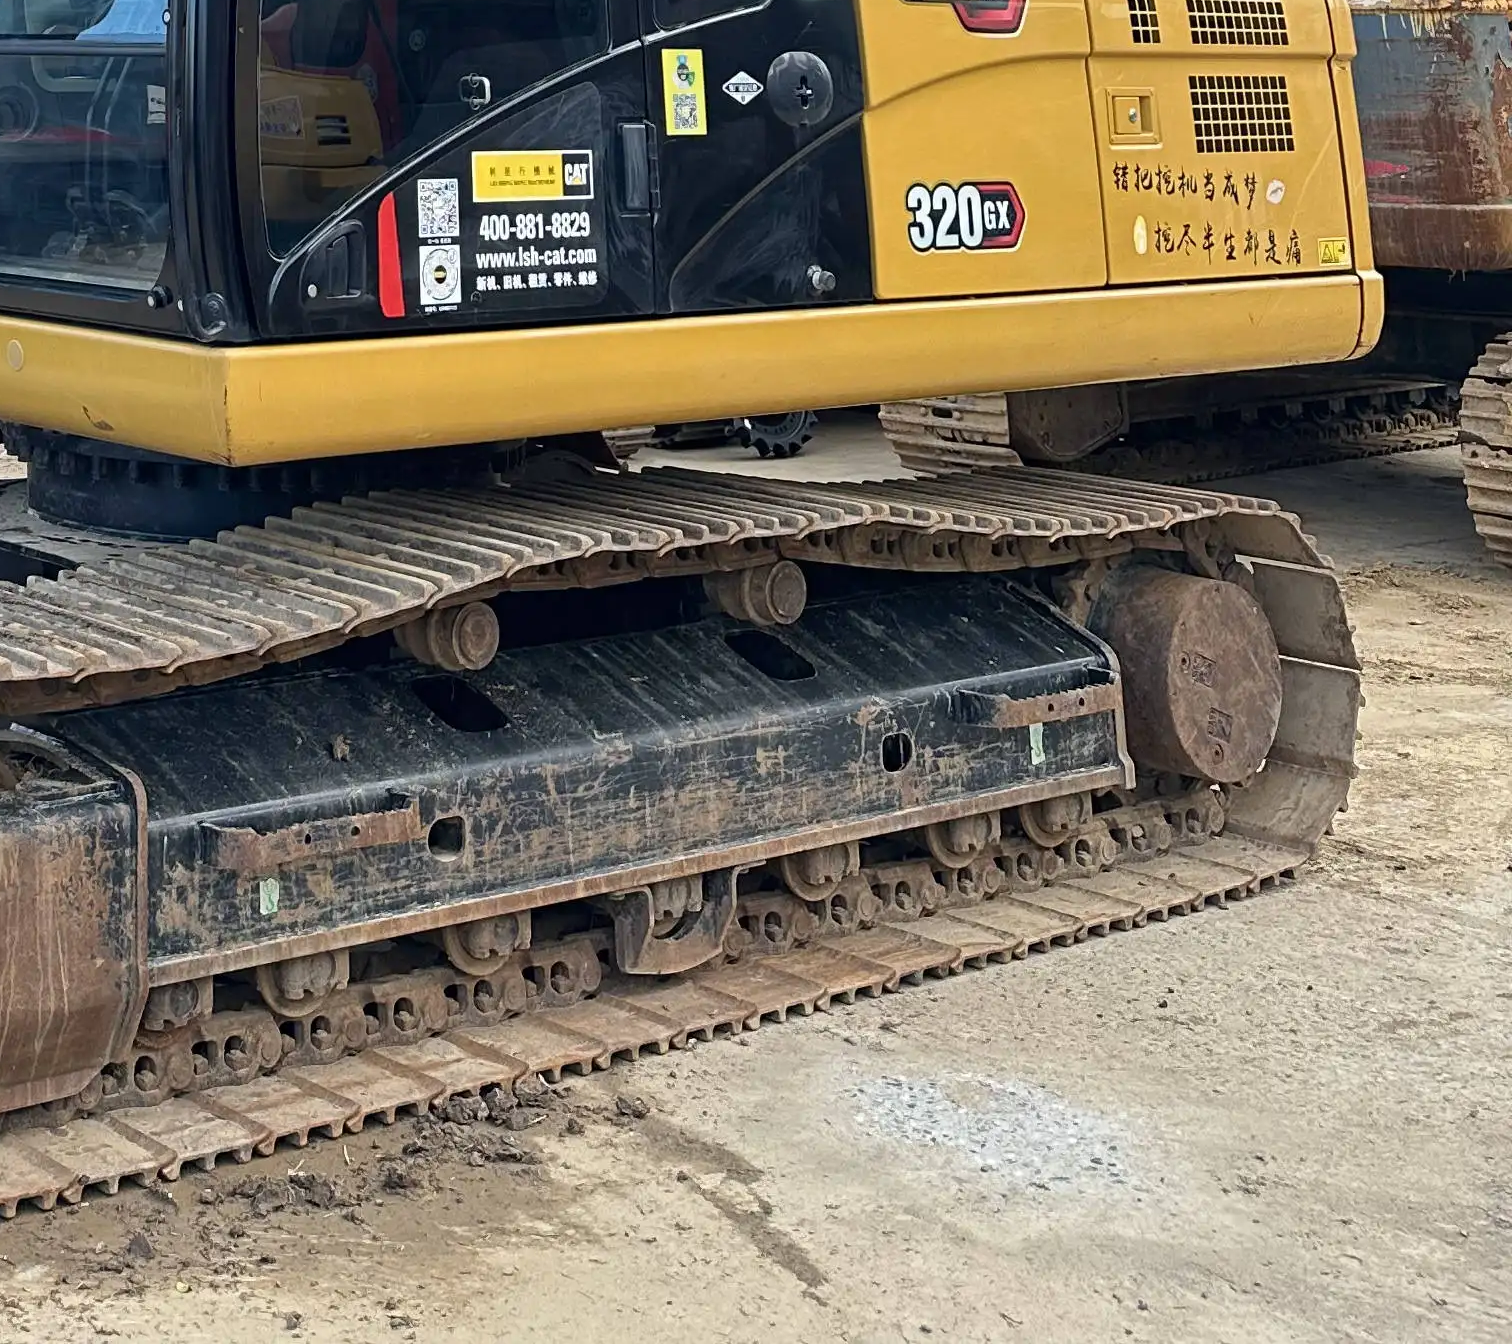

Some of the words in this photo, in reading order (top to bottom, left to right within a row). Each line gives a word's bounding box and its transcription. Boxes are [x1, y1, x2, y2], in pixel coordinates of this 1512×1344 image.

[564, 163, 589, 186] CAT
[1113, 161, 1258, 211] 错把挖机当成梦
[479, 211, 590, 241] 400-881-8829
[907, 184, 984, 249] 320
[983, 200, 1011, 231] GX
[476, 245, 597, 269] www.lsh-cat.com
[1154, 221, 1301, 266] 挖尽半生都是痛
